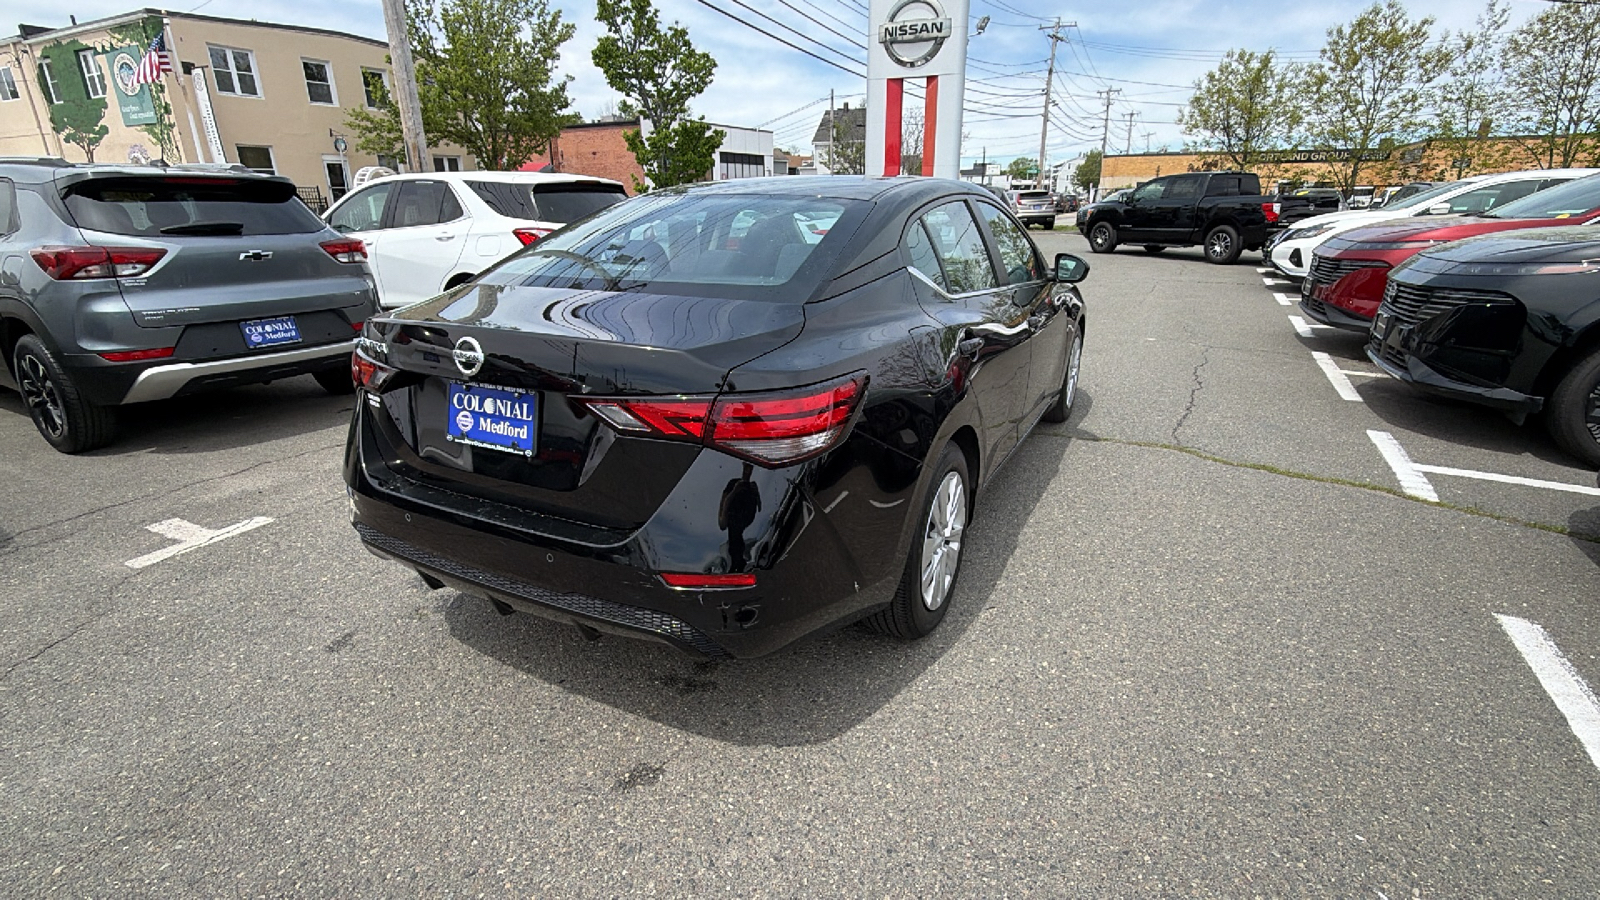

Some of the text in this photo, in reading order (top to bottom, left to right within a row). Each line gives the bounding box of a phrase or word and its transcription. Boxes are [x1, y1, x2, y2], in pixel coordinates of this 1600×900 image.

[884, 22, 943, 38] NISSAN
[245, 321, 296, 335] COLONIAL
[264, 330, 296, 340] Medford
[453, 392, 533, 421] COLONIAL
[478, 416, 528, 440] Medford
